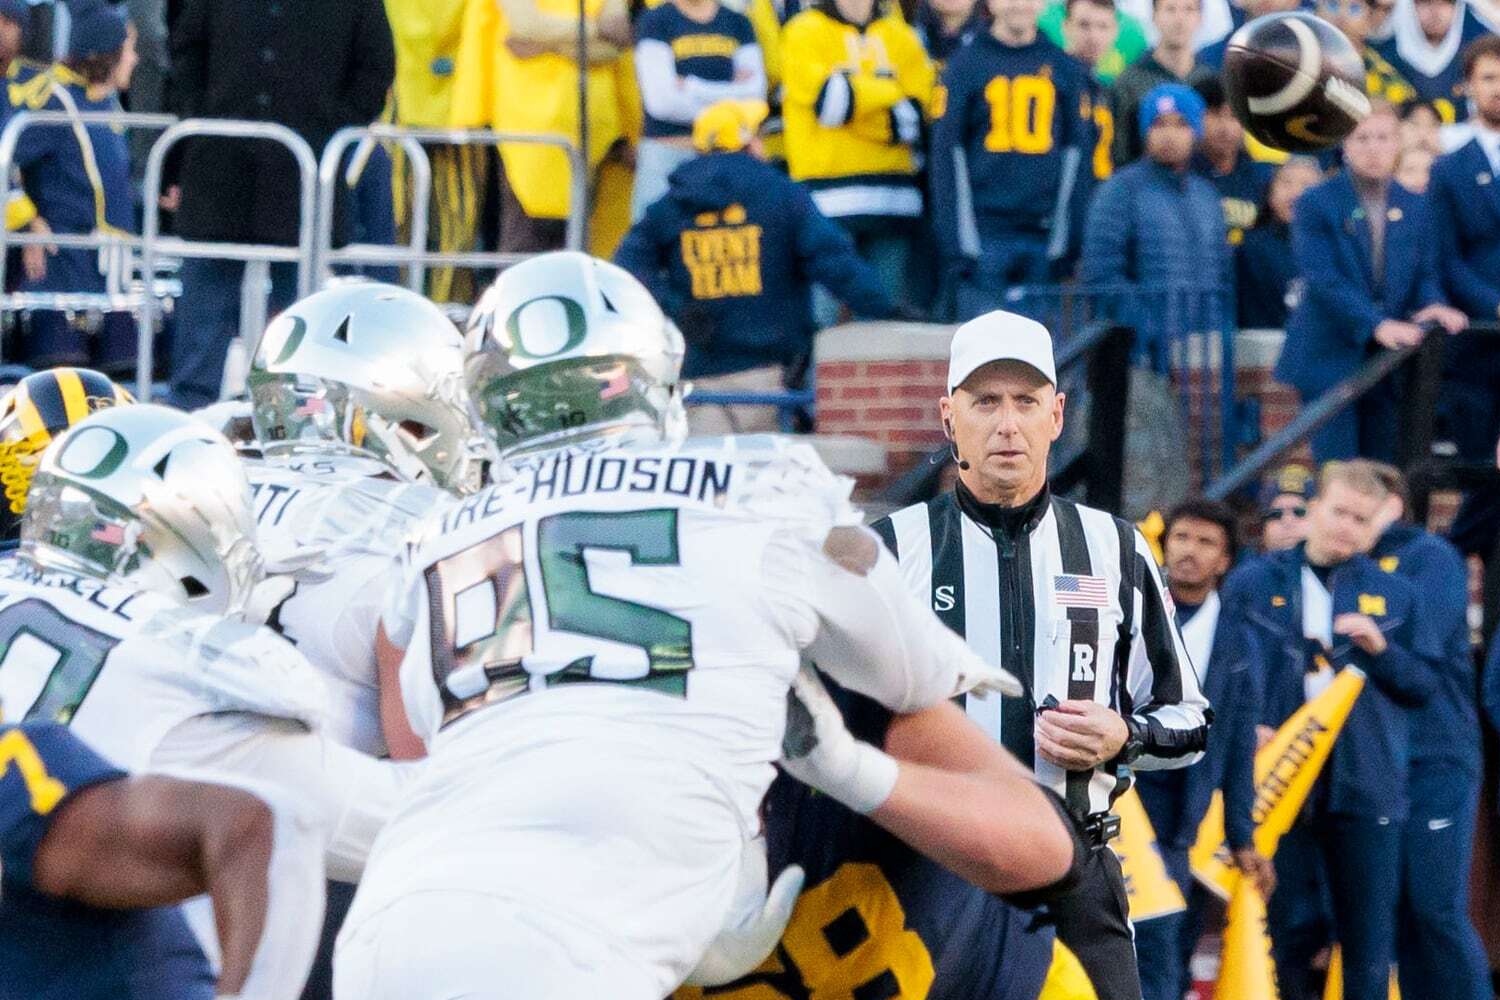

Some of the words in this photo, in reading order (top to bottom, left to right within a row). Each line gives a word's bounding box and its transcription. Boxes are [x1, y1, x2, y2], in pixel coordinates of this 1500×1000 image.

[984, 75, 1056, 154] 10
[506, 294, 588, 360] O
[55, 424, 129, 479] O
[935, 585, 956, 611] S
[1072, 644, 1095, 682] R
